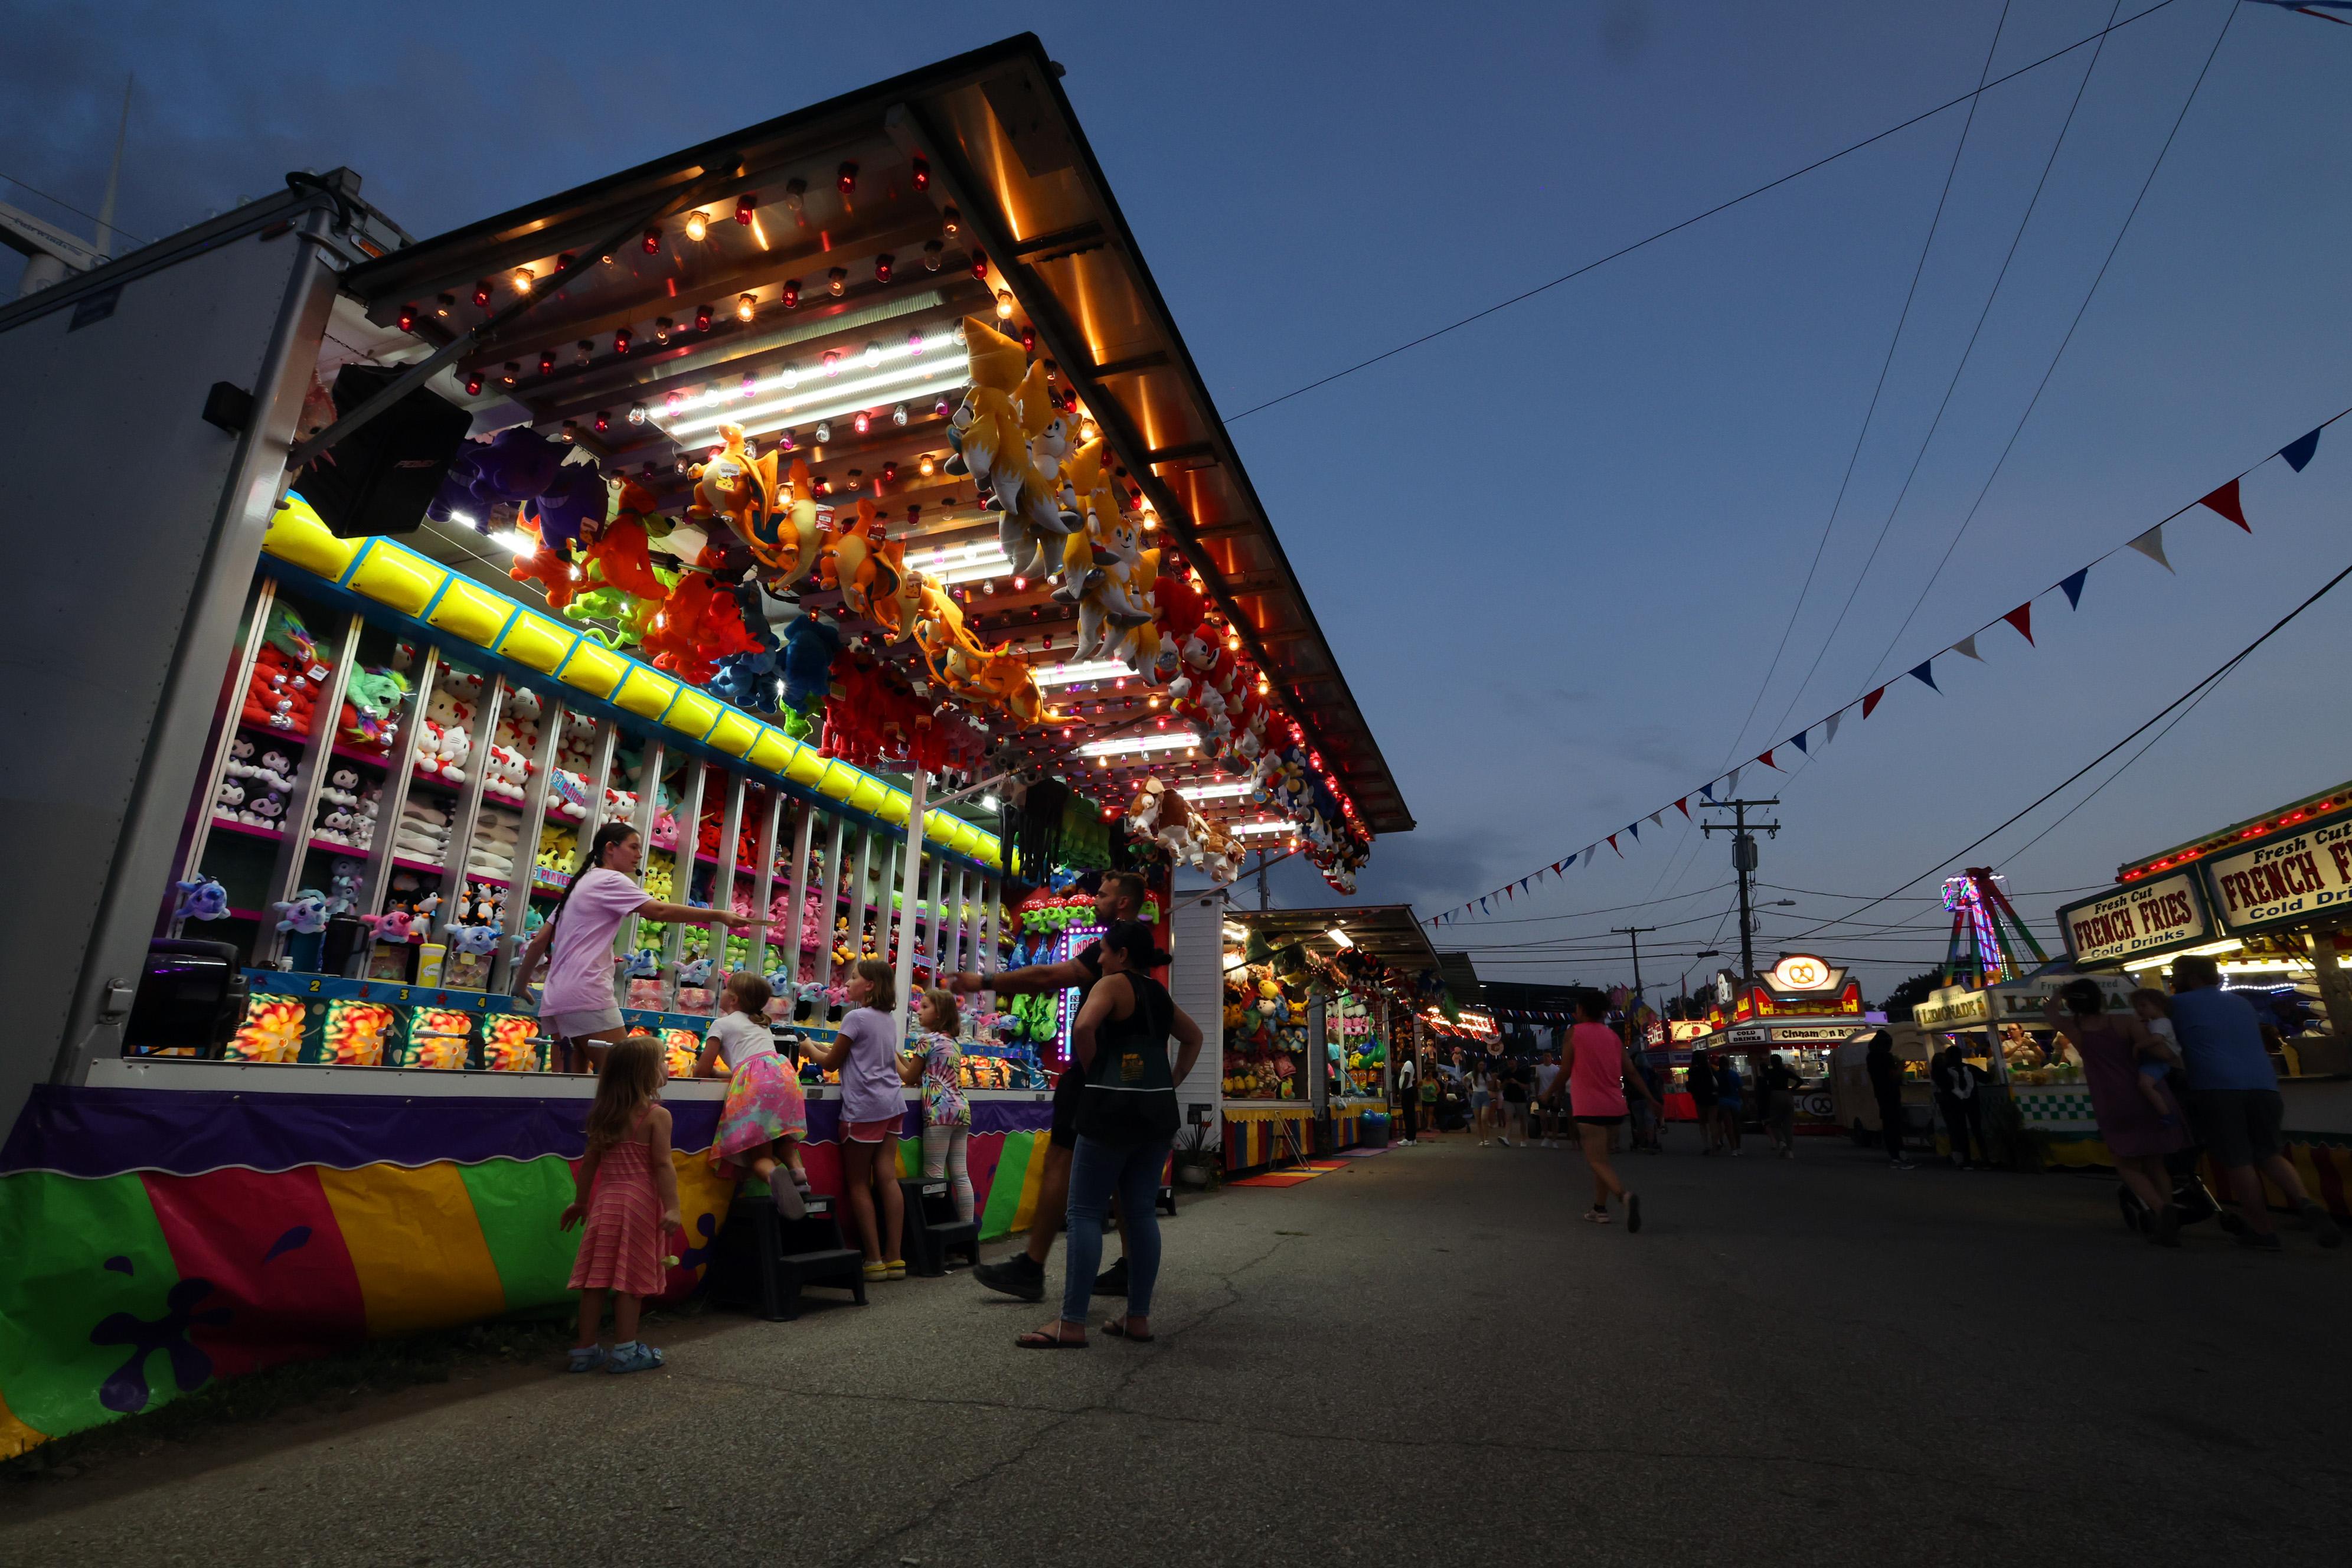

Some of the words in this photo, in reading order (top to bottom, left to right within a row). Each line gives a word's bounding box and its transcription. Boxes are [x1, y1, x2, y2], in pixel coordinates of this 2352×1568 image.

[2254, 838, 2307, 864] Fresh
[2315, 823, 2351, 844] Cut
[541, 869, 571, 886] PLAYER
[2220, 851, 2325, 912] FRENCH
[2095, 896, 2127, 914] Fresh
[2131, 887, 2152, 902] Cut
[2250, 899, 2302, 919] Cold
[2073, 907, 2136, 951] FRENCH
[2138, 890, 2192, 934] FRIES
[2092, 943, 2123, 958] Cold
[2132, 930, 2185, 949] Drinks
[309, 980, 321, 992] 2
[400, 988, 409, 1000] 3
[477, 997, 486, 1008] 4
[1922, 1001, 1977, 1024] LEMONADE
[658, 1015, 664, 1024] 7
[705, 1021, 711, 1029] 8
